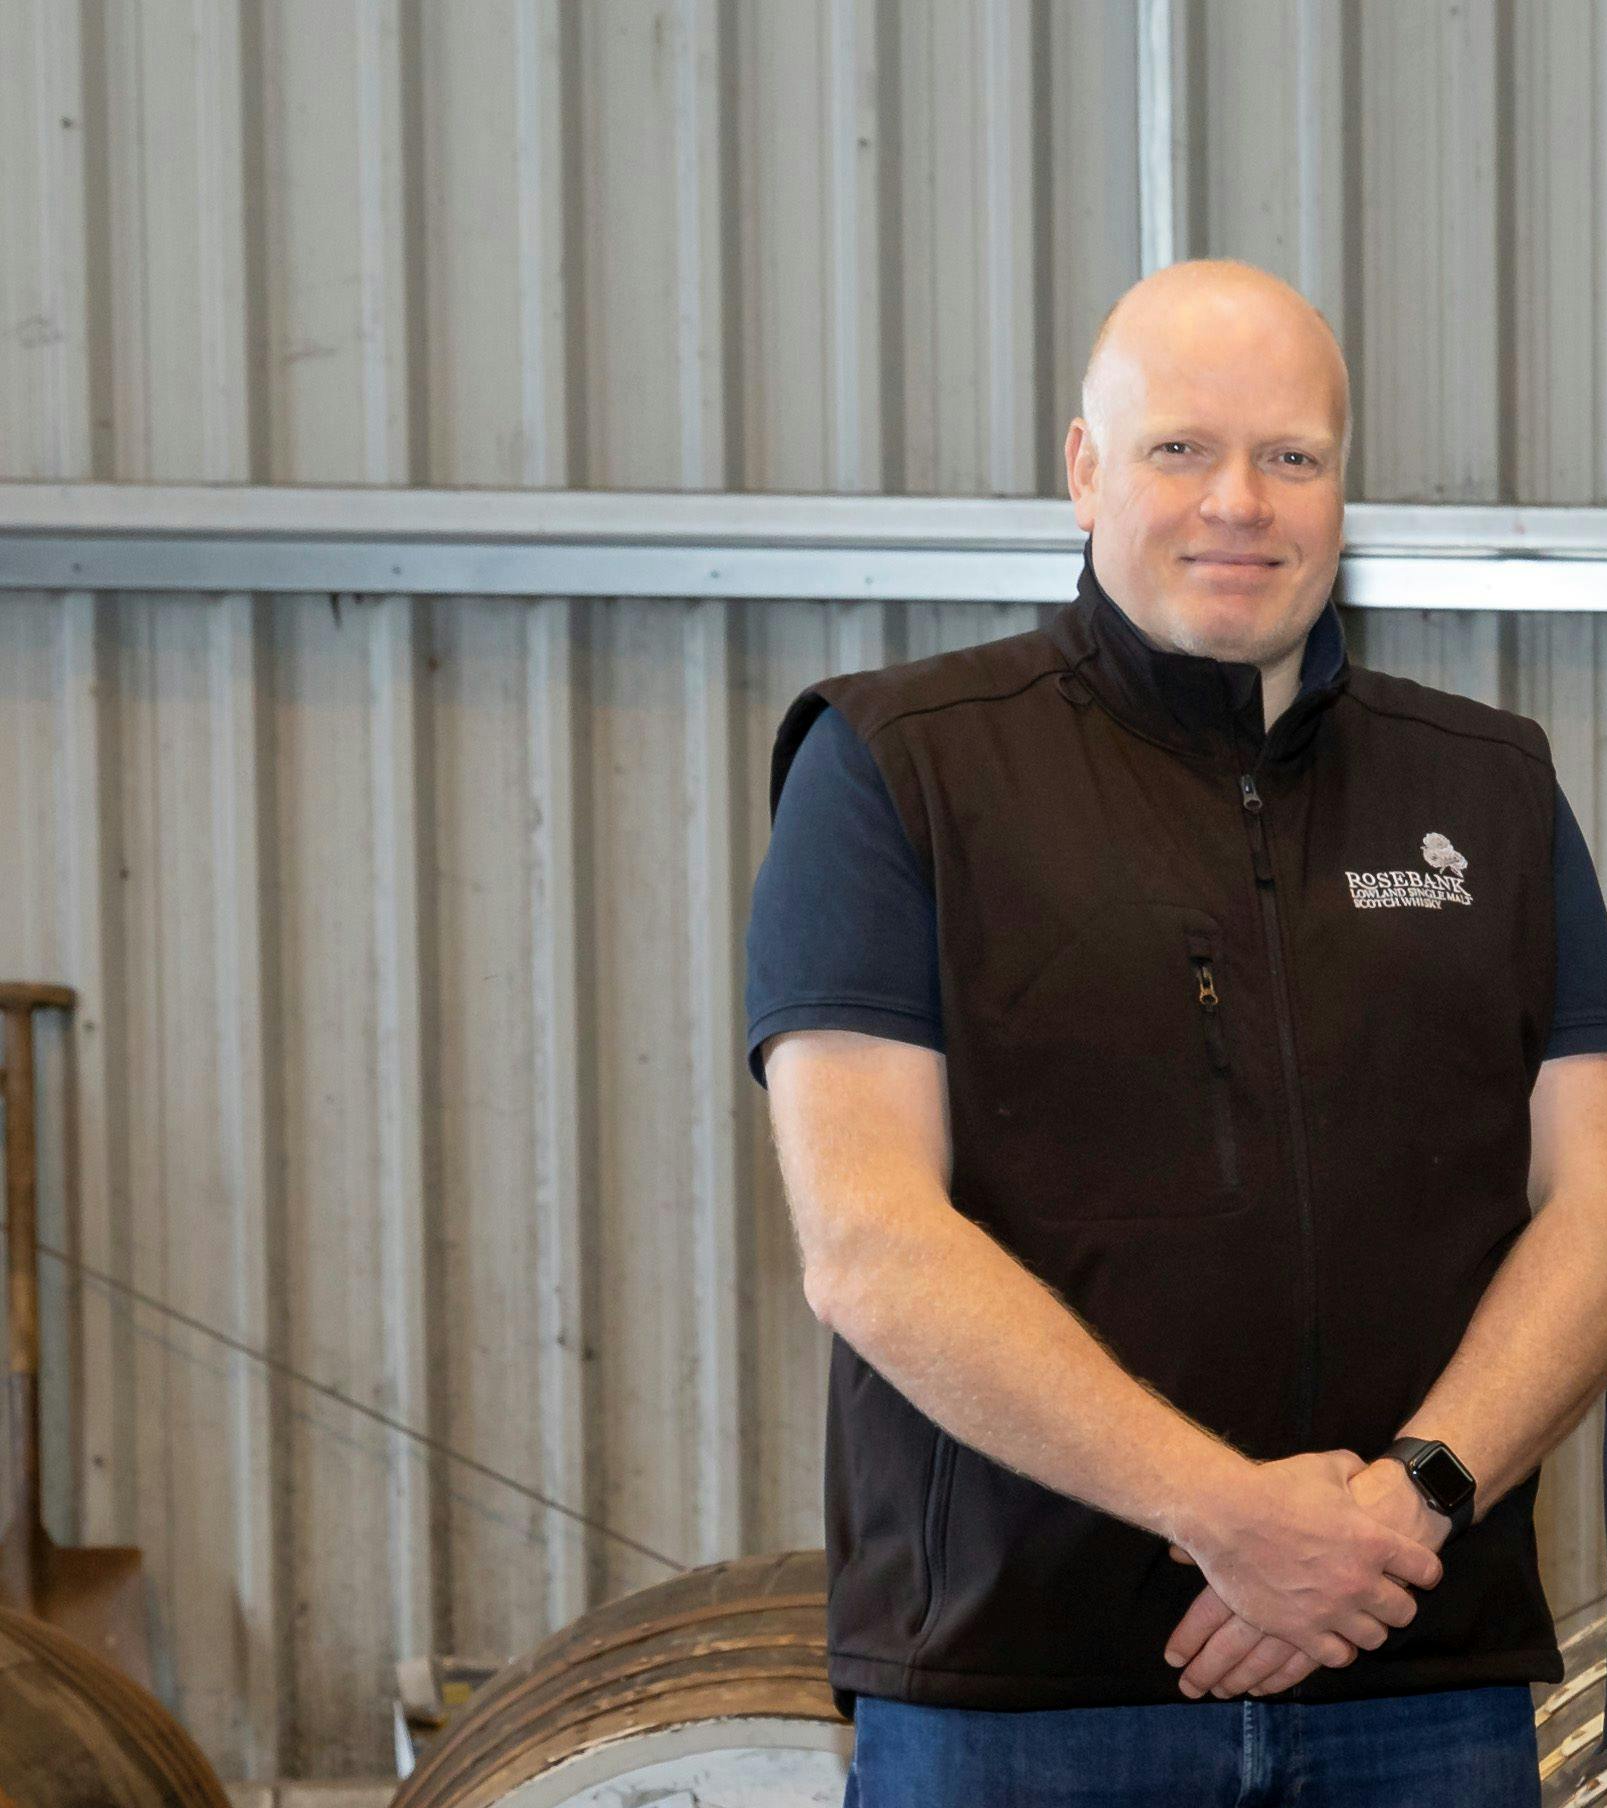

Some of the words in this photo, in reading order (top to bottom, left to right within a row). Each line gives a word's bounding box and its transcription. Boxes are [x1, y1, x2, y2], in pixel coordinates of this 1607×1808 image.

[1345, 871, 1472, 897] ROSEBANK
[1351, 888, 1406, 899] LOWLAND
[1408, 888, 1445, 901] SINGLE
[1445, 894, 1473, 906] MALT
[1353, 898, 1401, 910] SCOTCH
[1401, 899, 1443, 910] WHISKY
